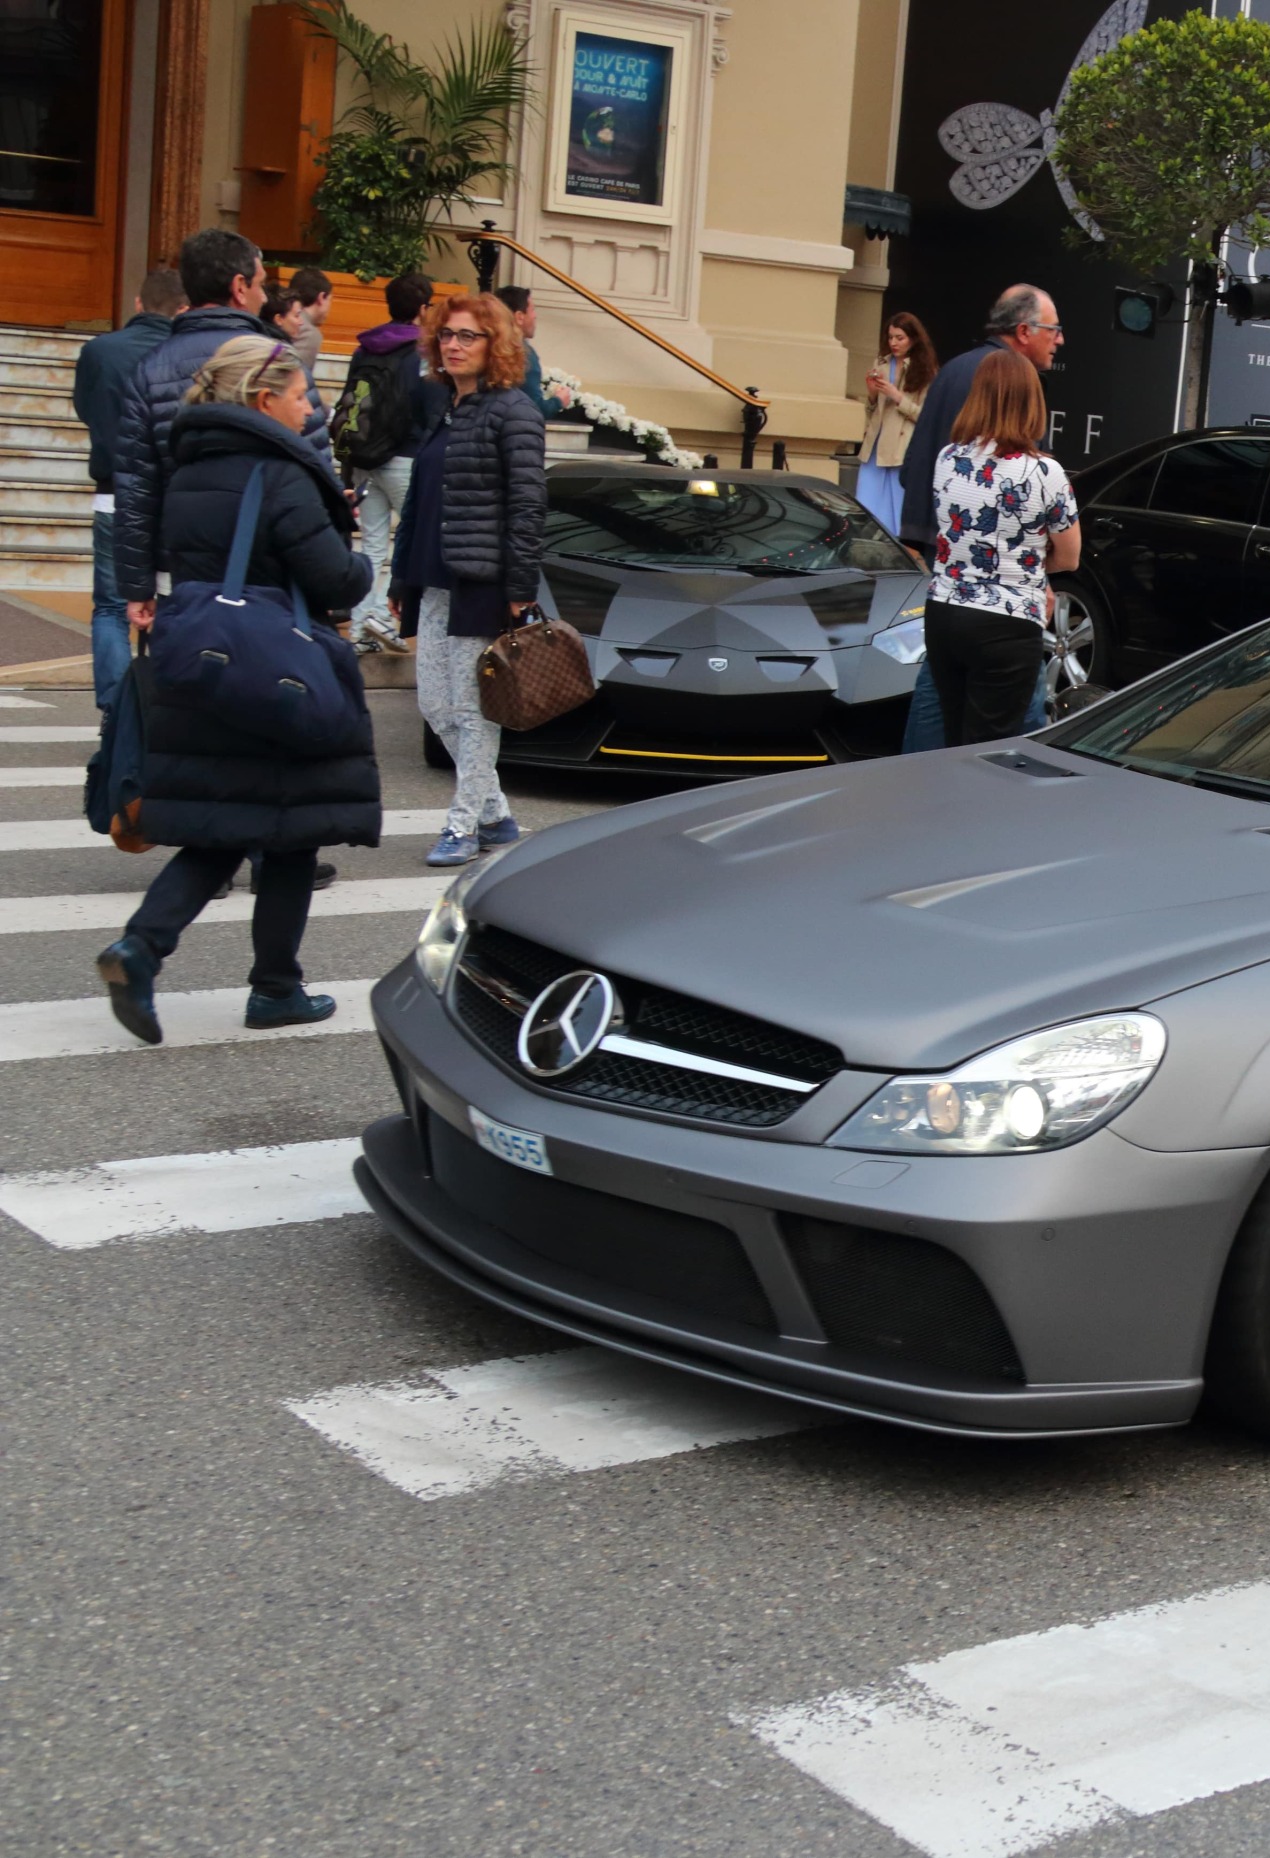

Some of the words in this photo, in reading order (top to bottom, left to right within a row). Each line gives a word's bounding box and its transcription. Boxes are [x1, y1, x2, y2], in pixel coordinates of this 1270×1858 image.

[575, 49, 650, 77] OUVERT
[607, 73, 616, 84] &
[582, 83, 648, 102] MONTE-CARLO
